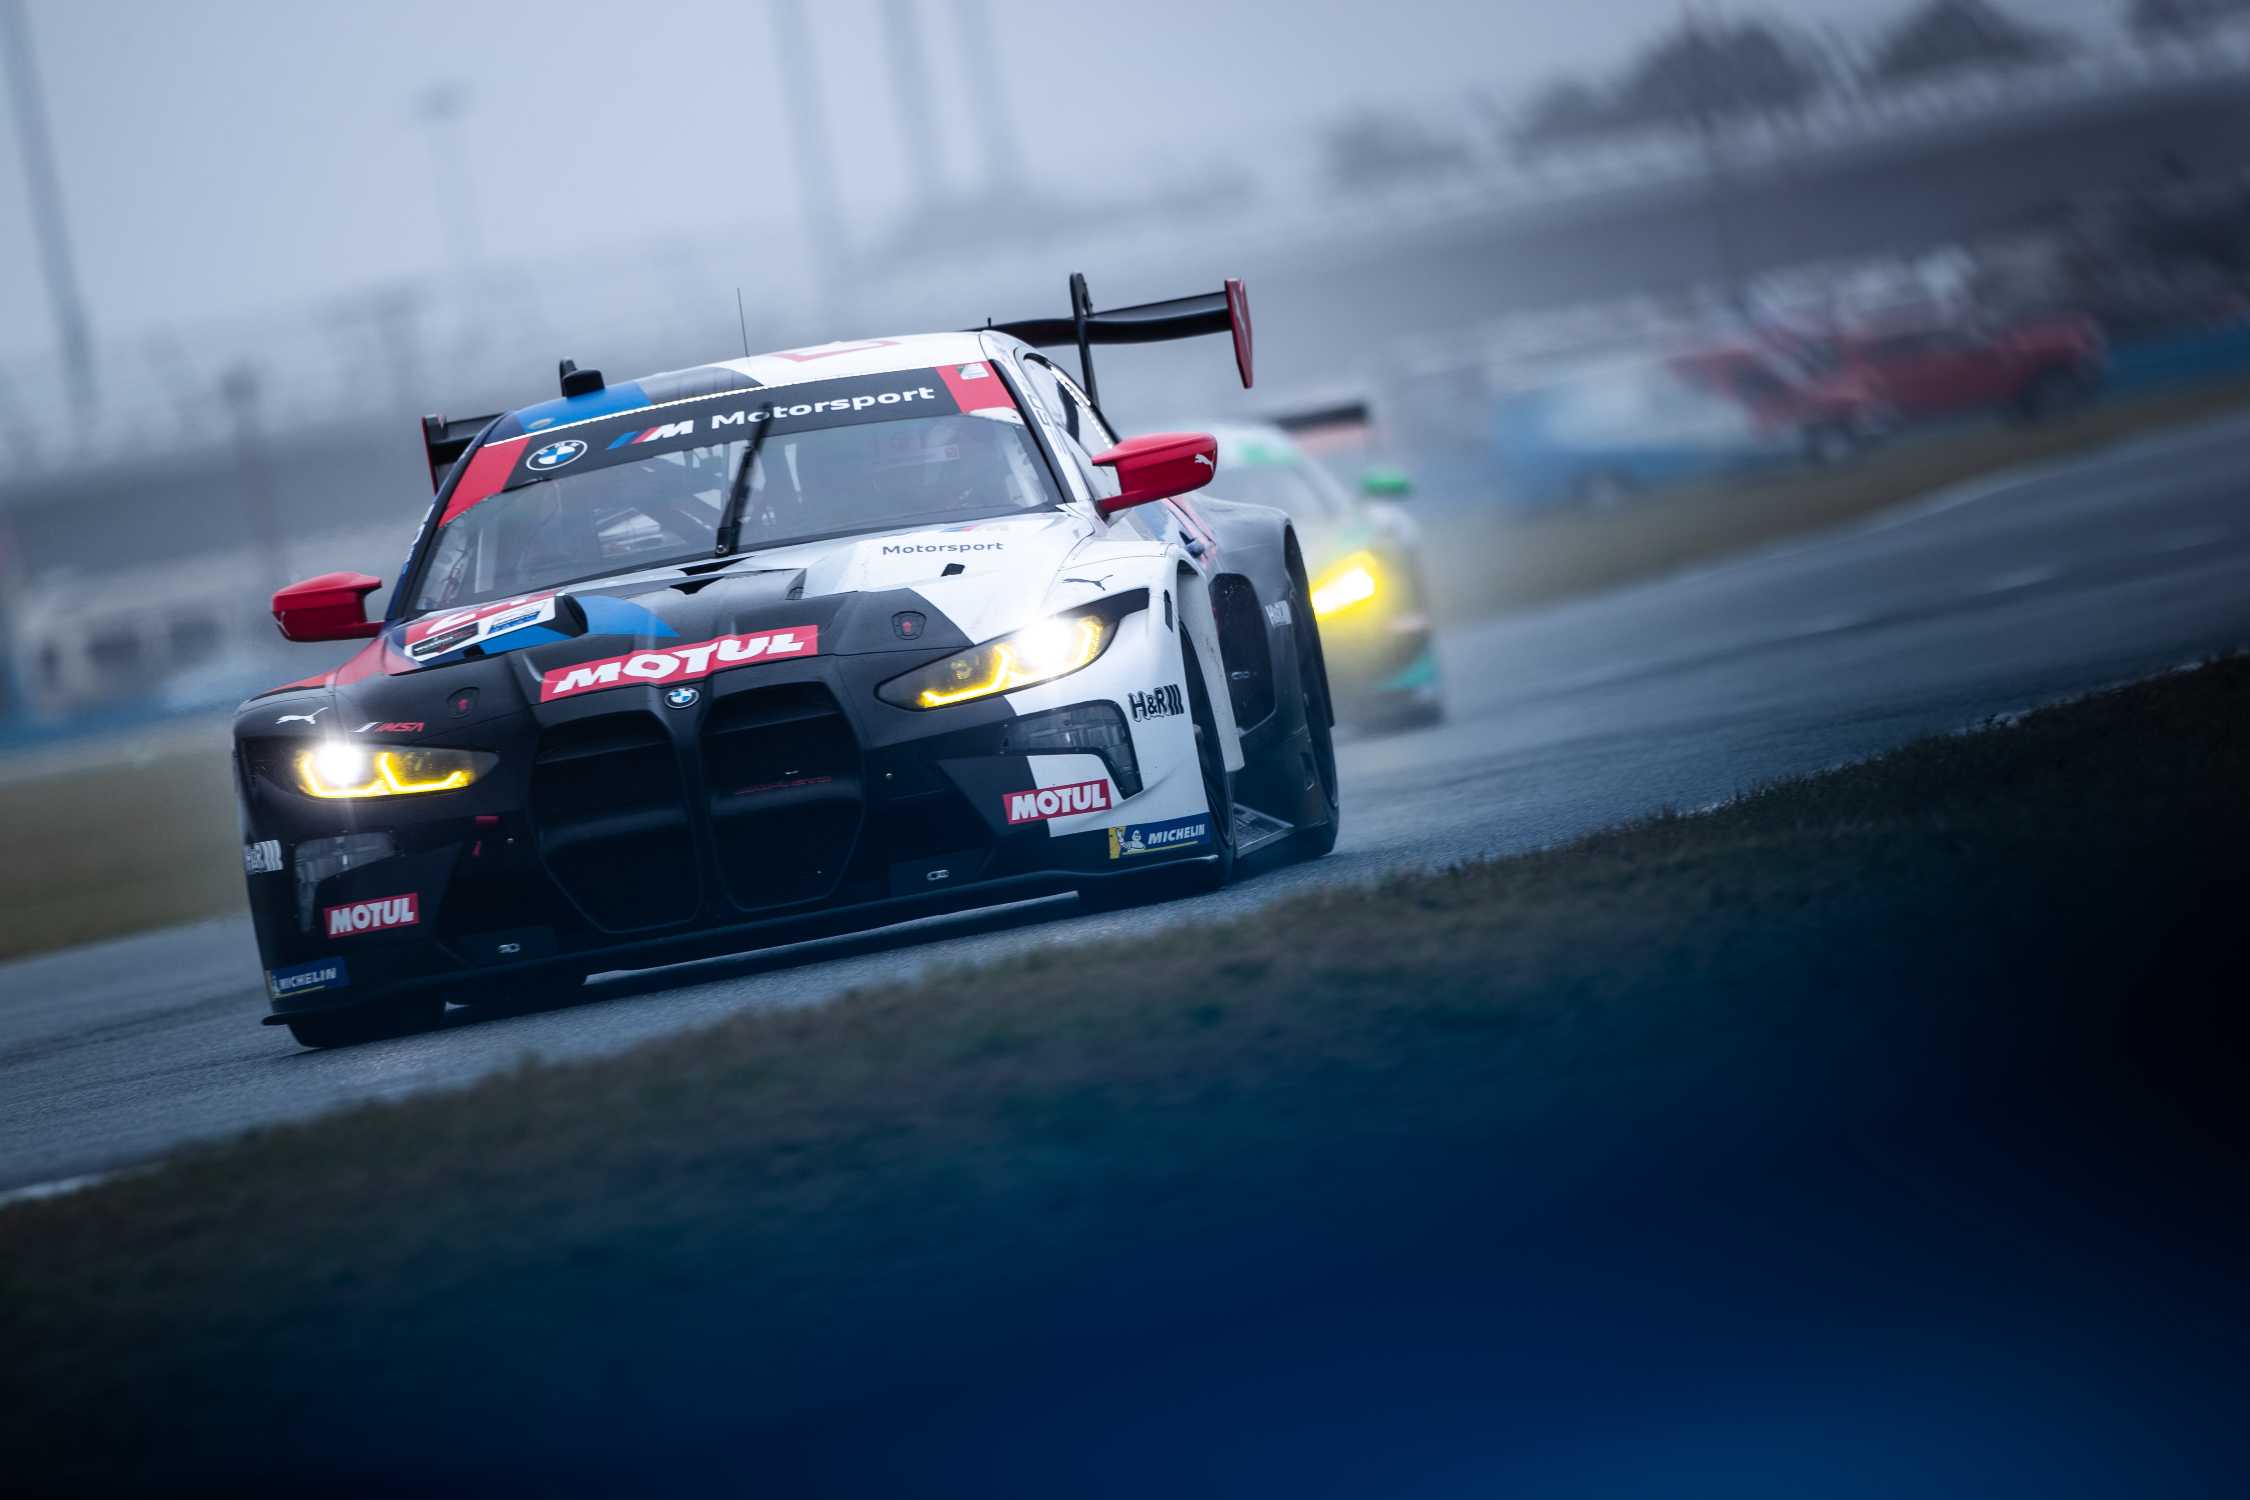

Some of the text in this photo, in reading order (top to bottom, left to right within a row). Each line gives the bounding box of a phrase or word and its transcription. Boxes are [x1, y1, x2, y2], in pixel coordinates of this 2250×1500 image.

[711, 386, 937, 429] Motorsport
[882, 541, 1004, 555] Motorsport
[552, 632, 806, 693] MOTUL
[1010, 783, 1107, 821] MOTUL
[1147, 823, 1206, 846] MICHELIN
[328, 897, 415, 935] MOTUL
